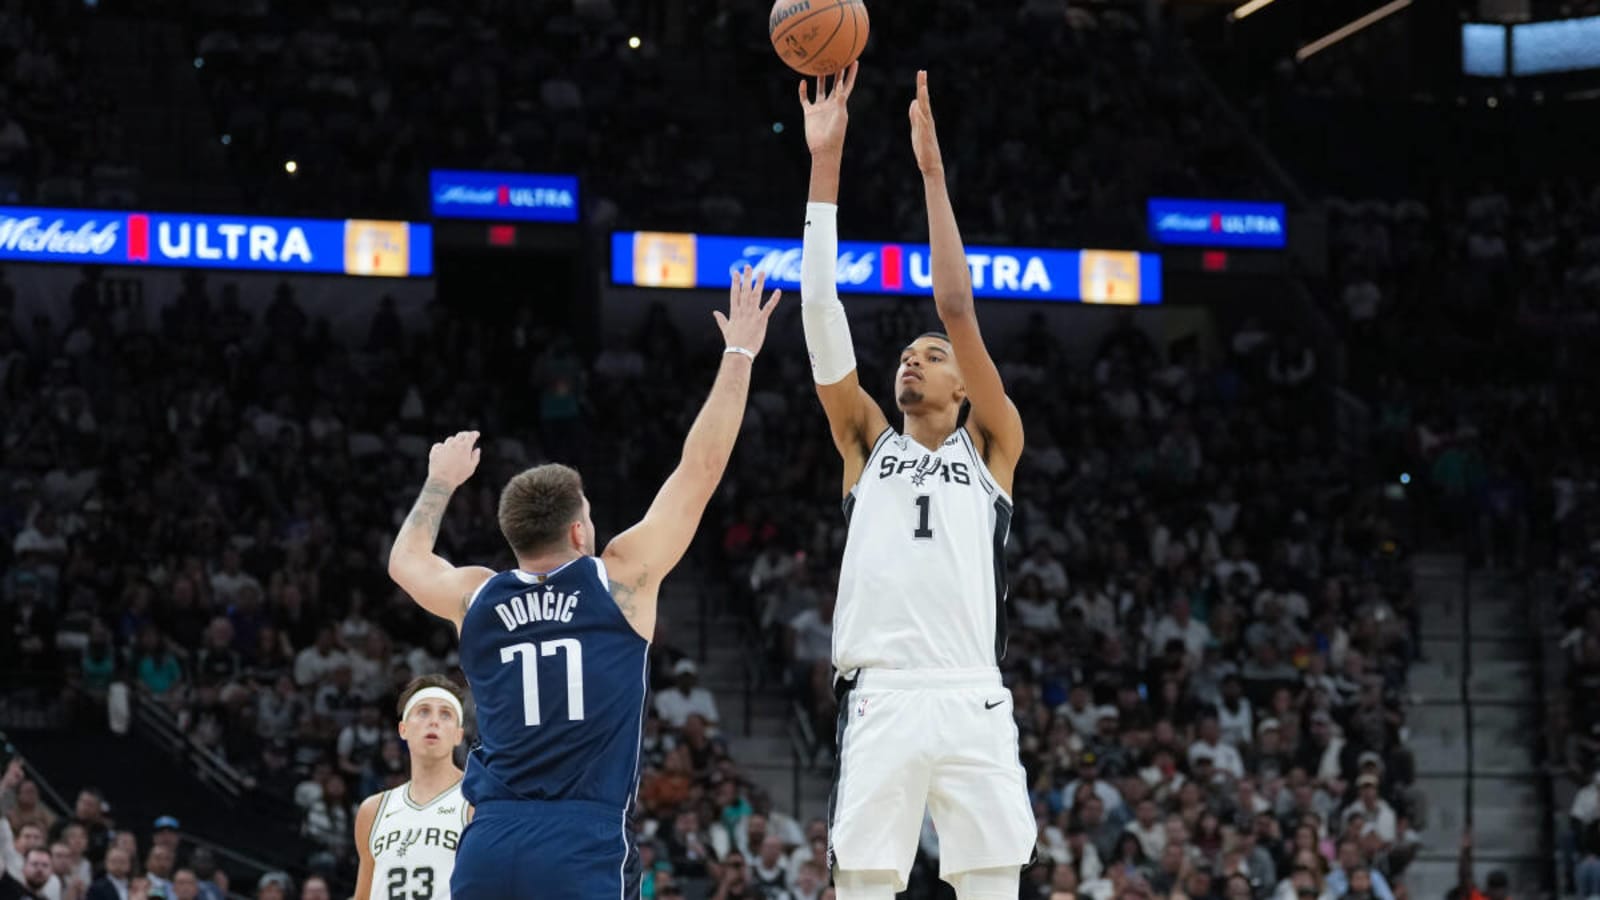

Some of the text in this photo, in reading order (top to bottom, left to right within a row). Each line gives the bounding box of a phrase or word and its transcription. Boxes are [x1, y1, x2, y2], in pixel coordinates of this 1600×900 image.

[509, 188, 574, 207] ULTRA
[159, 221, 313, 263] ULTRA
[909, 252, 1052, 292] UTRA
[914, 495, 933, 538] 1
[495, 585, 581, 632] DONČIĆ
[500, 638, 584, 726] 77
[437, 806, 456, 815] Self
[374, 827, 459, 858] SPURS
[387, 866, 434, 900] 23
